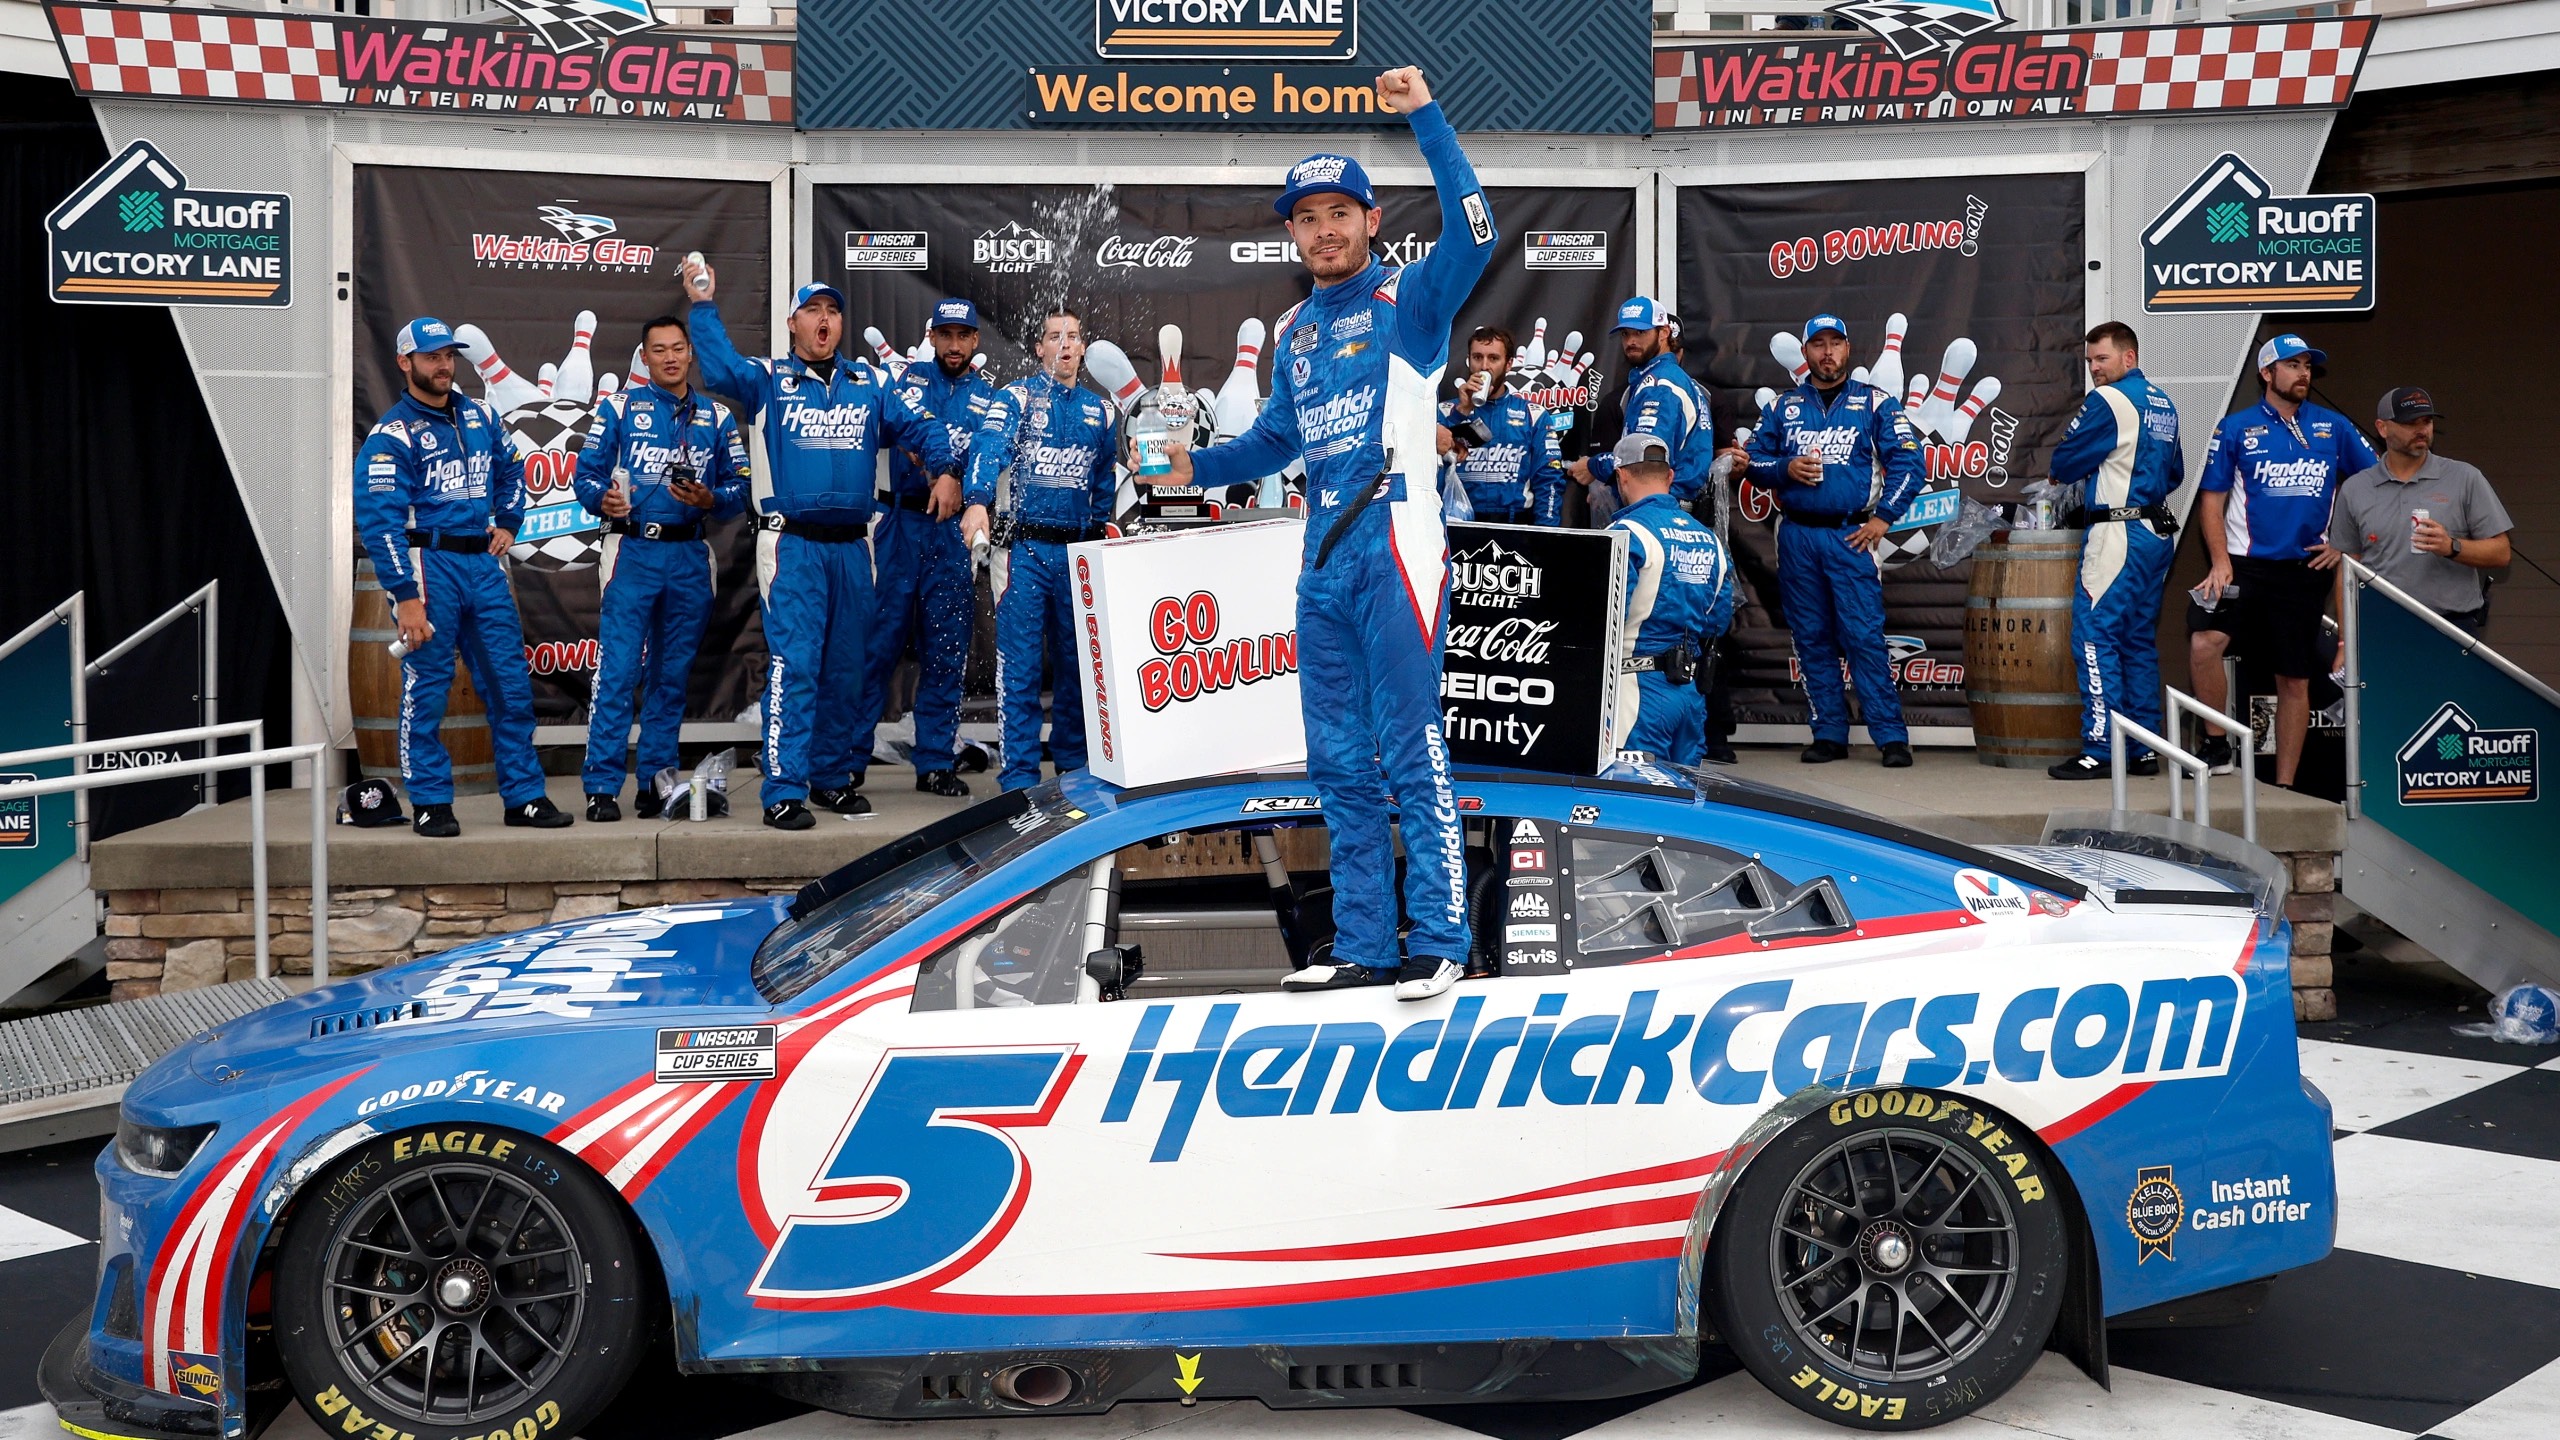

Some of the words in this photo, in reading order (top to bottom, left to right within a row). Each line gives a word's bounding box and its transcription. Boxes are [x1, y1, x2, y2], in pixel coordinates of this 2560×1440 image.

[1112, 0, 1243, 23] VICTORY
[1259, 0, 1344, 24] LANE
[342, 29, 594, 91] Watkins
[608, 45, 733, 97] Glen
[1702, 52, 1940, 104] Watkins
[1954, 44, 2082, 95] Glen
[348, 88, 725, 117] INTERNATIONAL
[1035, 72, 1256, 113] Welcome
[1707, 98, 2074, 124] INTERNATIONAL
[1292, 157, 1347, 181] Hendrick
[173, 198, 280, 229] Ruoff
[2258, 203, 2363, 235] Ruoff
[174, 233, 279, 250] MORTGAGE
[473, 234, 590, 263] Watkins
[593, 238, 655, 266] Glen
[872, 235, 916, 246] NASCAR
[973, 239, 1052, 263] BUSCH
[1096, 235, 1198, 268] Coca-Cola
[1230, 241, 1302, 262] GEIC
[1383, 233, 1437, 262] xfin
[1551, 235, 1595, 246] NASCAR
[1769, 236, 1818, 279] GO
[1824, 220, 1964, 265] BOWLING
[2258, 238, 2362, 255] MORTGAGE
[61, 251, 194, 275] VICTORY
[203, 255, 281, 279] LANE
[477, 261, 649, 273] INTERNATIONAL
[857, 251, 875, 261] CUP
[877, 251, 917, 261] SERIES
[989, 263, 1035, 273] LIGHT
[1536, 251, 1557, 261] CUP
[1559, 251, 1596, 261] SERIES
[2153, 262, 2277, 285] VICTORY
[2286, 260, 2363, 283] LANE
[1331, 308, 1373, 334] Hendrick
[1295, 385, 1377, 434] Hendrick
[1512, 387, 1588, 412] OWLING
[781, 403, 870, 432] Hendrick
[1305, 411, 1370, 443] cars.com
[800, 424, 865, 438] cars.com
[1786, 427, 1860, 451] Hendrick
[629, 440, 715, 470] Hendrick
[1465, 443, 1527, 461] endrick
[1464, 459, 1519, 472] cars.com
[2253, 458, 2330, 483] Hendrick
[1157, 485, 1199, 495] WINNER
[1372, 479, 1392, 500] 5
[2268, 474, 2326, 488] cars.com
[523, 508, 572, 536] THE
[1892, 494, 1956, 527] LEN
[1670, 544, 1716, 566] Hendrick
[1459, 594, 1519, 609] LIGHT
[1150, 590, 1220, 655] GO
[1446, 616, 1560, 664] ca-Cola
[1077, 555, 1094, 610] GO
[1086, 612, 1114, 762] BOWLING
[1137, 630, 1299, 713] BOWLIN
[1904, 658, 1965, 685] Glen
[1441, 671, 1555, 706] EICO
[770, 655, 783, 777] HendrickCars.com
[1443, 706, 1546, 756] finity
[2468, 735, 2531, 755] Ruoff
[88, 751, 182, 770] LENORA
[2469, 757, 2531, 767] MORTGAGE
[2405, 771, 2481, 787] VICTORY
[2485, 770, 2532, 784] LANE
[0, 802, 29, 812] GAGE
[1425, 723, 1465, 925] HendrickCars.com
[1187, 836, 1242, 847] WINE
[1509, 836, 1545, 844] AXALTA
[1166, 854, 1252, 866] CELLAR
[1513, 851, 1544, 868] CI
[1511, 892, 1550, 911] MAC
[1966, 896, 2025, 913] VALVOLINE
[1511, 910, 1550, 918] TOOLS
[1511, 929, 1551, 937] SIEMENS
[693, 1030, 758, 1048] NASCAR
[673, 1055, 702, 1069] CUP
[704, 1052, 758, 1068] SERIES
[1099, 974, 2243, 1163] HendrickCars.com
[357, 1070, 566, 1116] GOODYEAR
[393, 1130, 517, 1163] EAGLE
[1829, 1090, 2045, 1204] GOODYEAR
[746, 1043, 1088, 1310] 5
[2137, 1184, 2175, 1204] KELLEY
[2211, 1174, 2291, 1204] Instant
[2132, 1206, 2154, 1219] BLUE
[2155, 1202, 2179, 1216] BOOK
[2191, 1205, 2245, 1231] Cash
[2251, 1199, 2312, 1225] Offer
[2137, 1220, 2160, 1236] OFFICIAL
[2159, 1217, 2175, 1233] GUIDE
[178, 1371, 221, 1388] SUNOC
[1790, 1364, 1907, 1420] EAGLE
